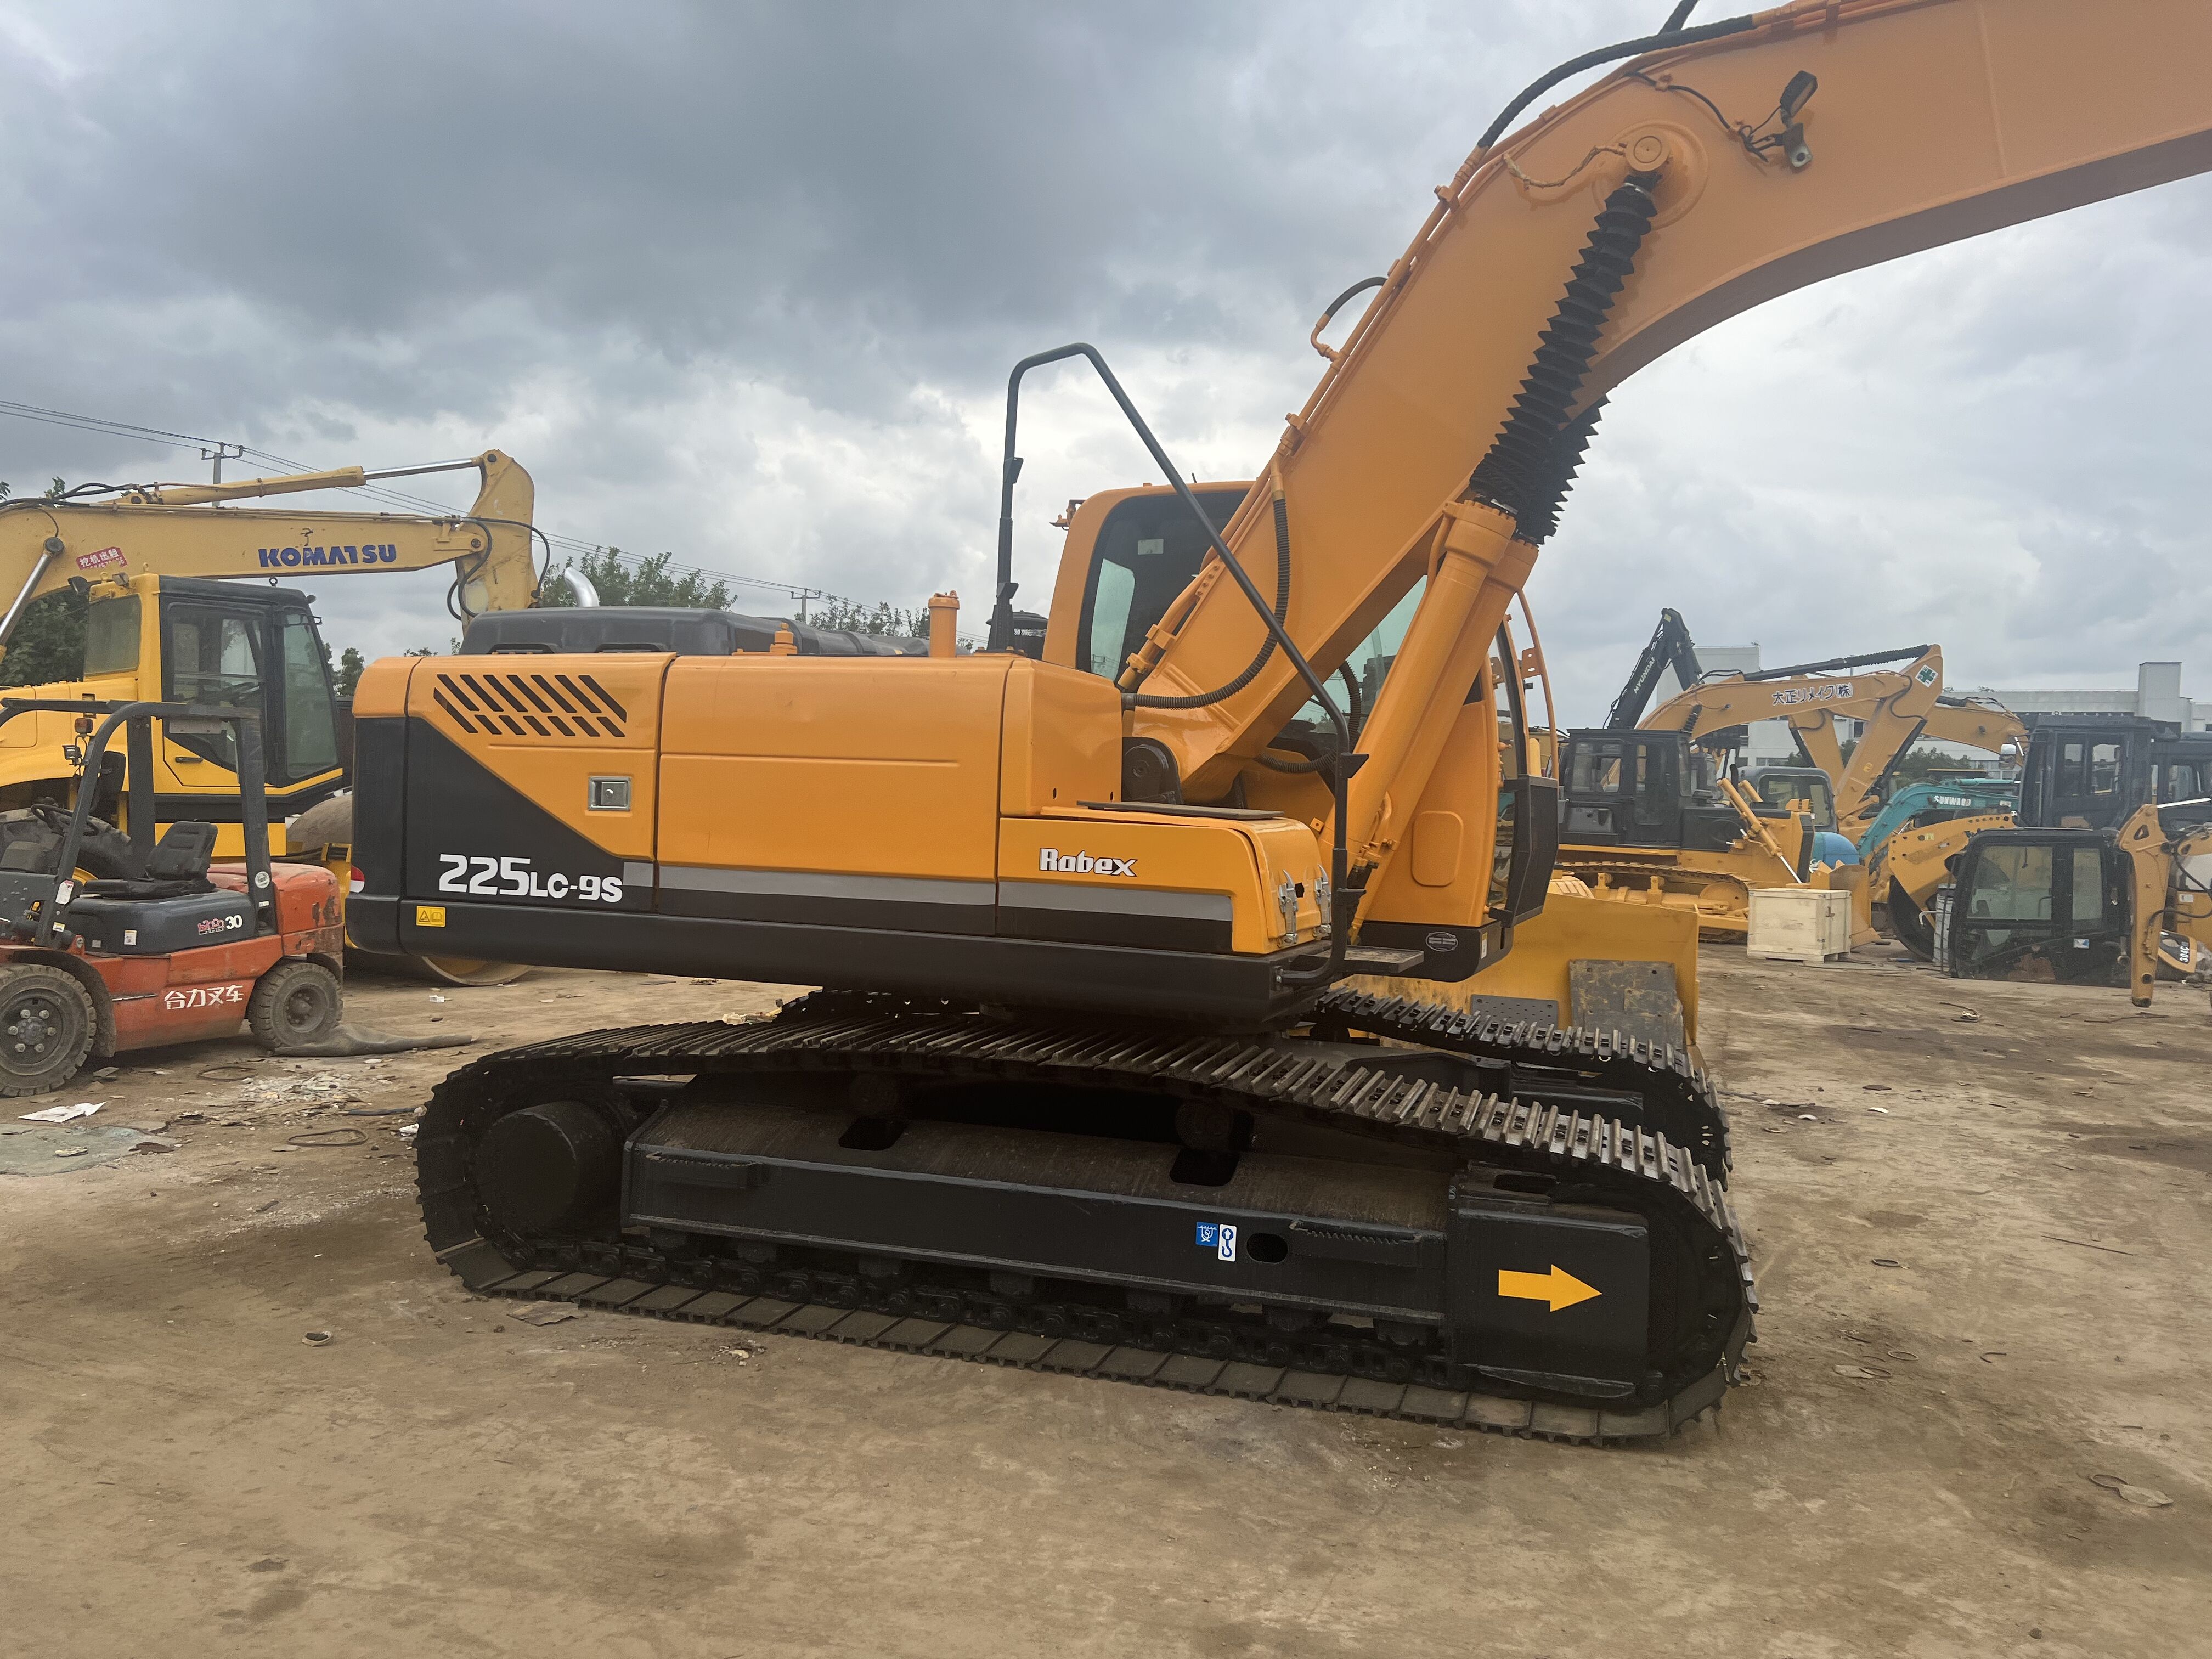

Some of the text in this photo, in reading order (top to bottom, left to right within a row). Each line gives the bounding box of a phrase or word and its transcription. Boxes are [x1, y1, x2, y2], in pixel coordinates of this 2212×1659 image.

[80, 549, 120, 568] 挖机出租
[258, 544, 397, 567] KOMATSU
[1634, 657, 1655, 694] HYUNDAI
[1934, 795, 1971, 806] SUNWARD
[1039, 848, 1138, 877] Robex
[439, 854, 623, 902] 225LC-9S
[225, 915, 242, 929] 30
[2179, 946, 2190, 962] 304C
[165, 985, 244, 1010] 合力叉车
